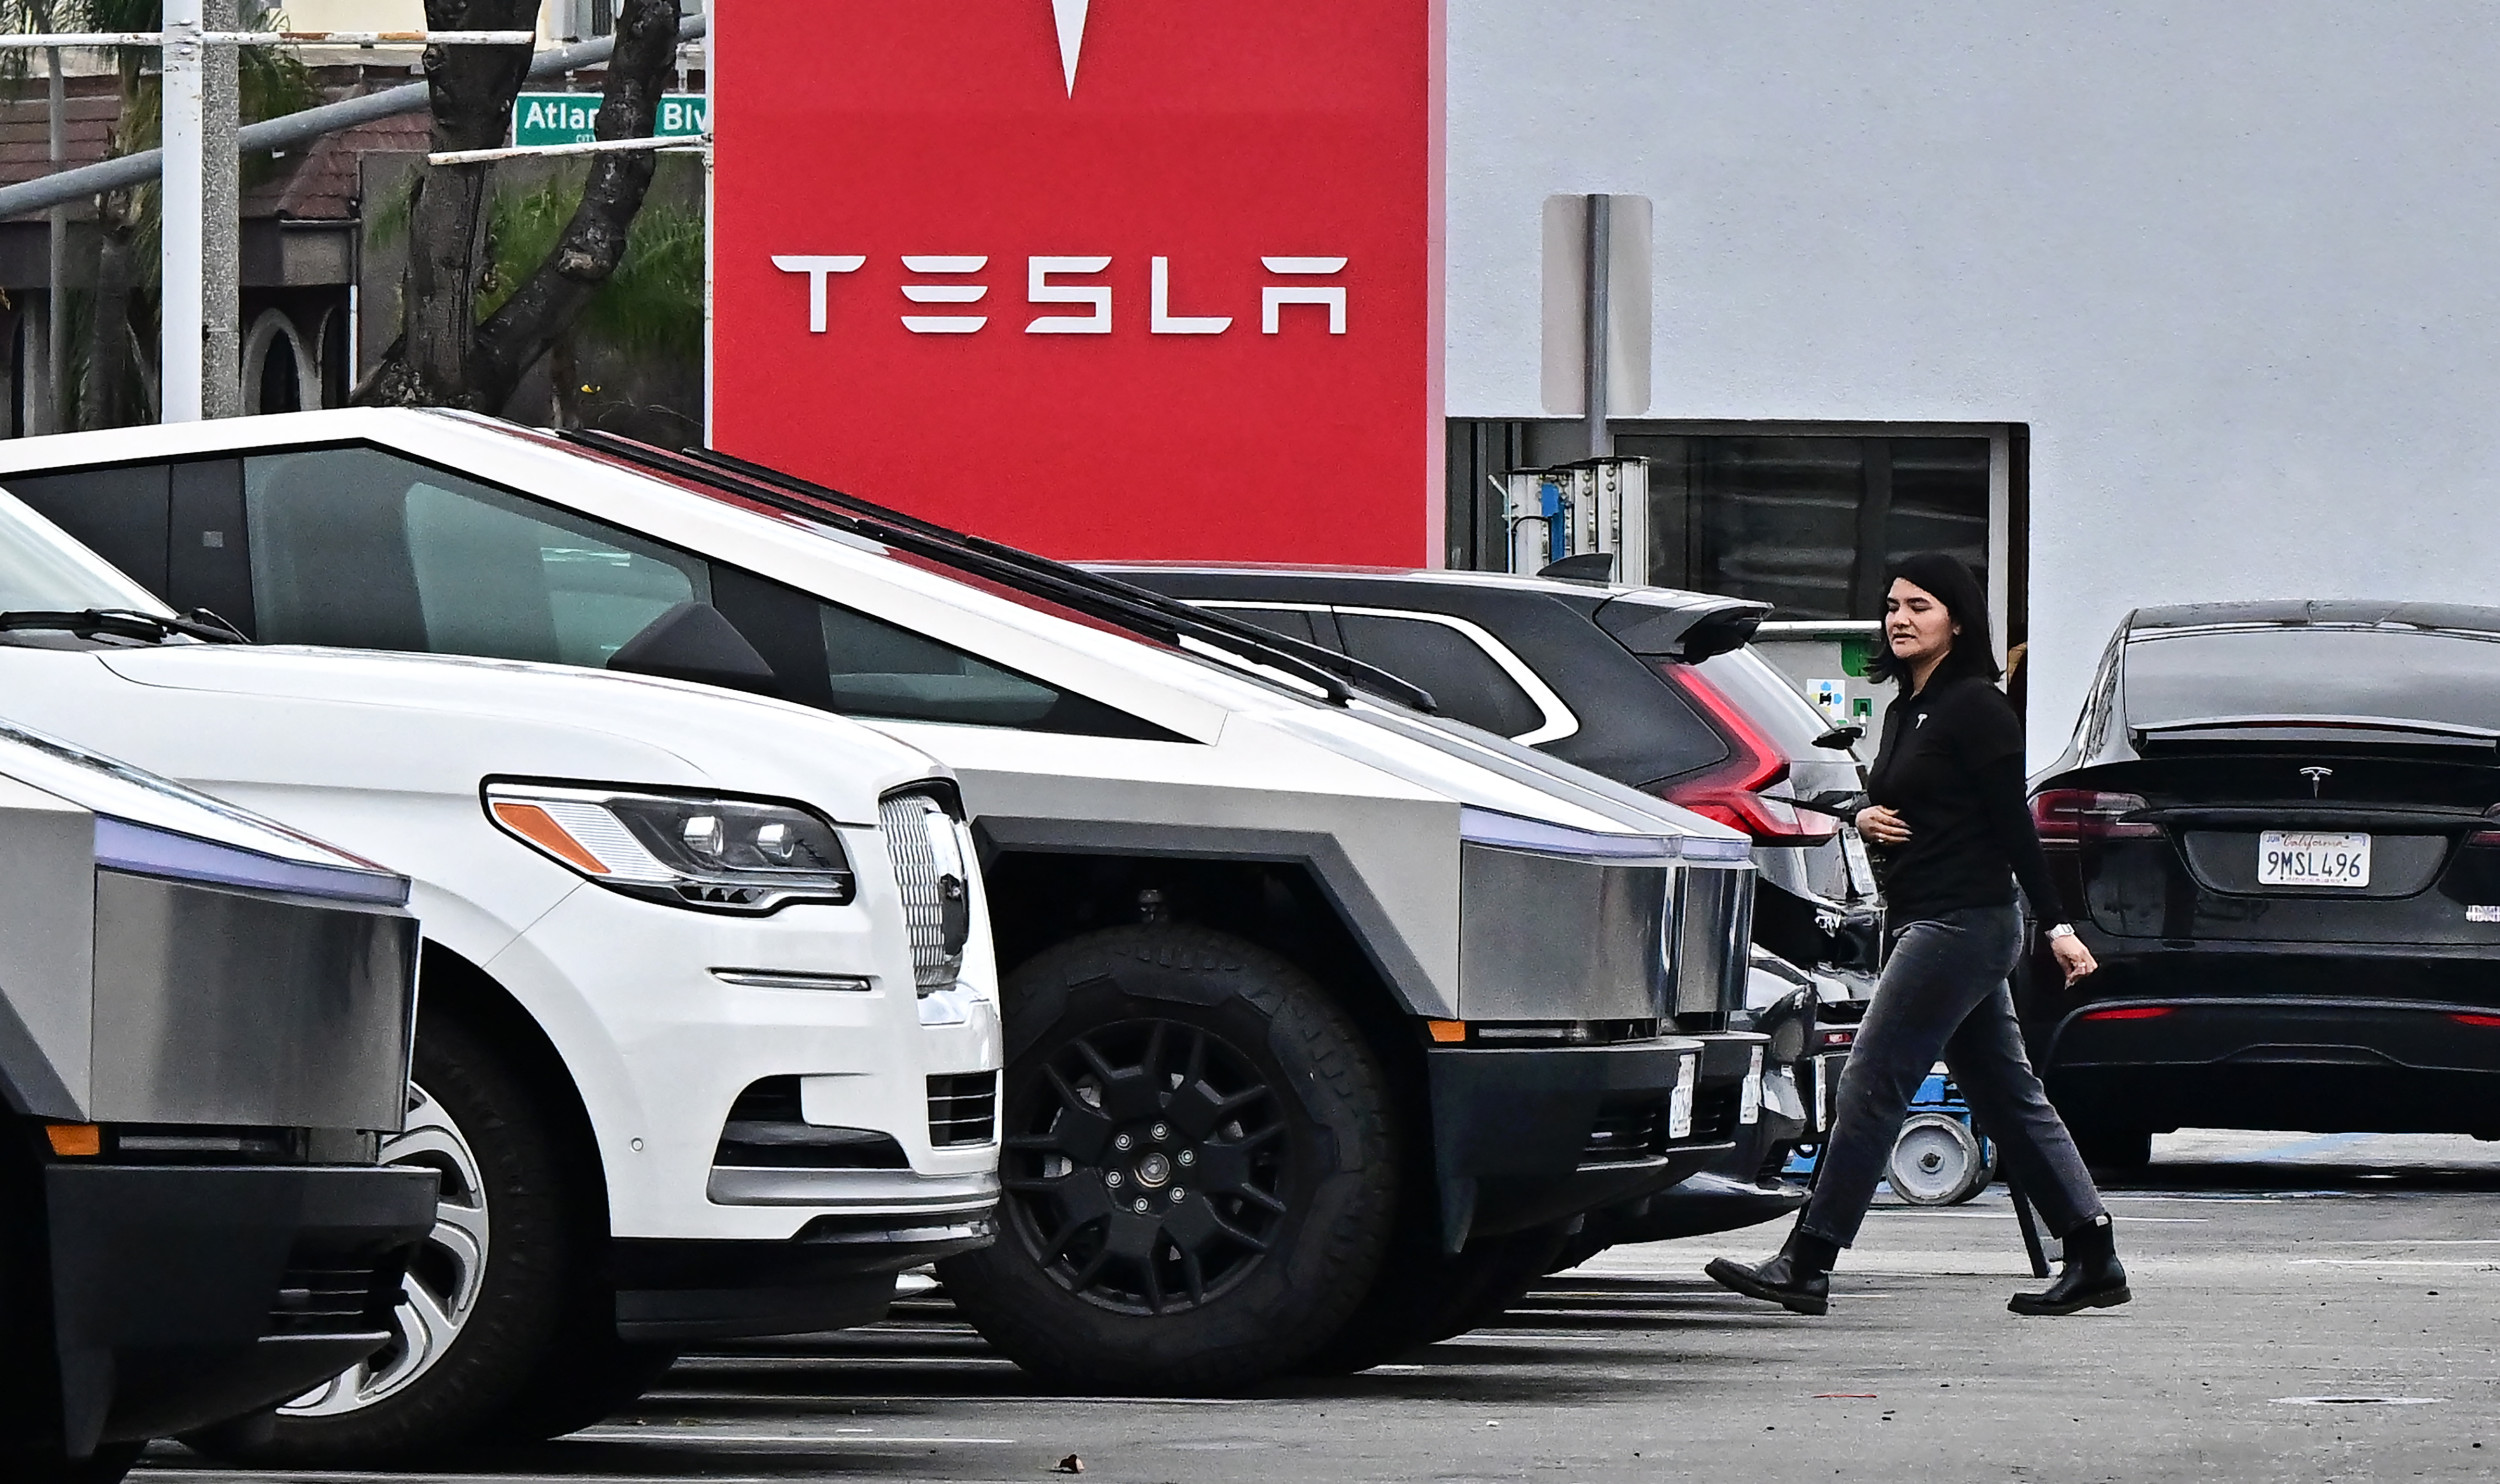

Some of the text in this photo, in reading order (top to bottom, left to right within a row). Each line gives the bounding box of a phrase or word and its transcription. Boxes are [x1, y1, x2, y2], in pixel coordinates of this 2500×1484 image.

[770, 255, 1348, 334] TESLA
[2283, 834, 2349, 851] California
[2267, 851, 2362, 878] 9MSL496
